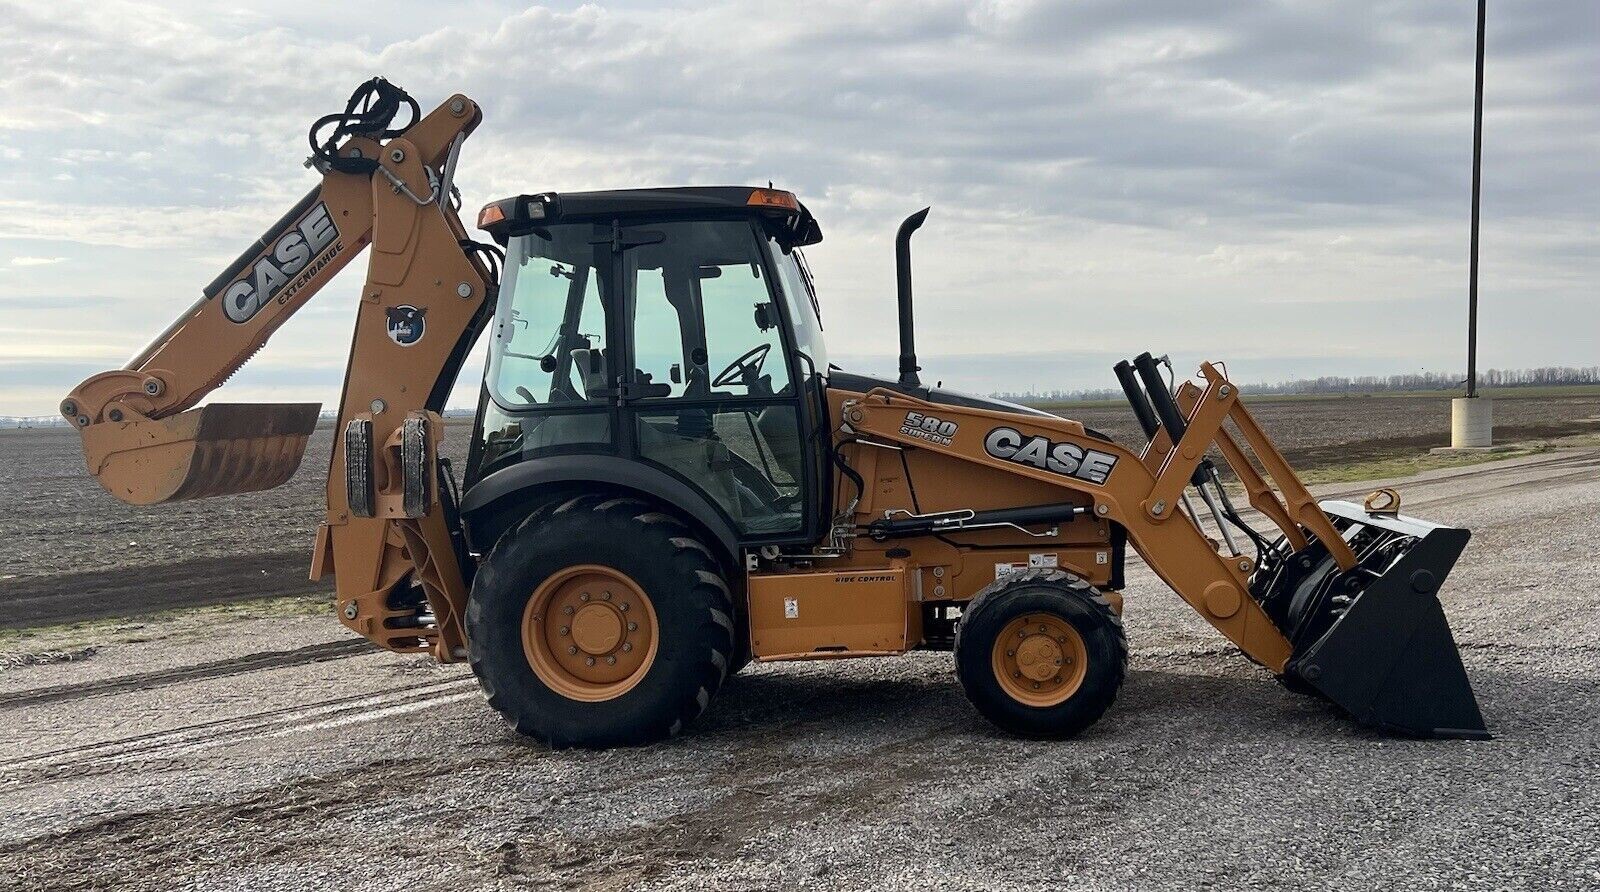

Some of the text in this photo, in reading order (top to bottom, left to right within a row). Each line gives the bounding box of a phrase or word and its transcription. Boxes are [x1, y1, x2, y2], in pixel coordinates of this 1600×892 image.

[223, 202, 340, 322] CASE
[278, 241, 344, 305] EXTENDAHOE
[904, 411, 958, 437] 580
[984, 426, 1118, 485] CASE
